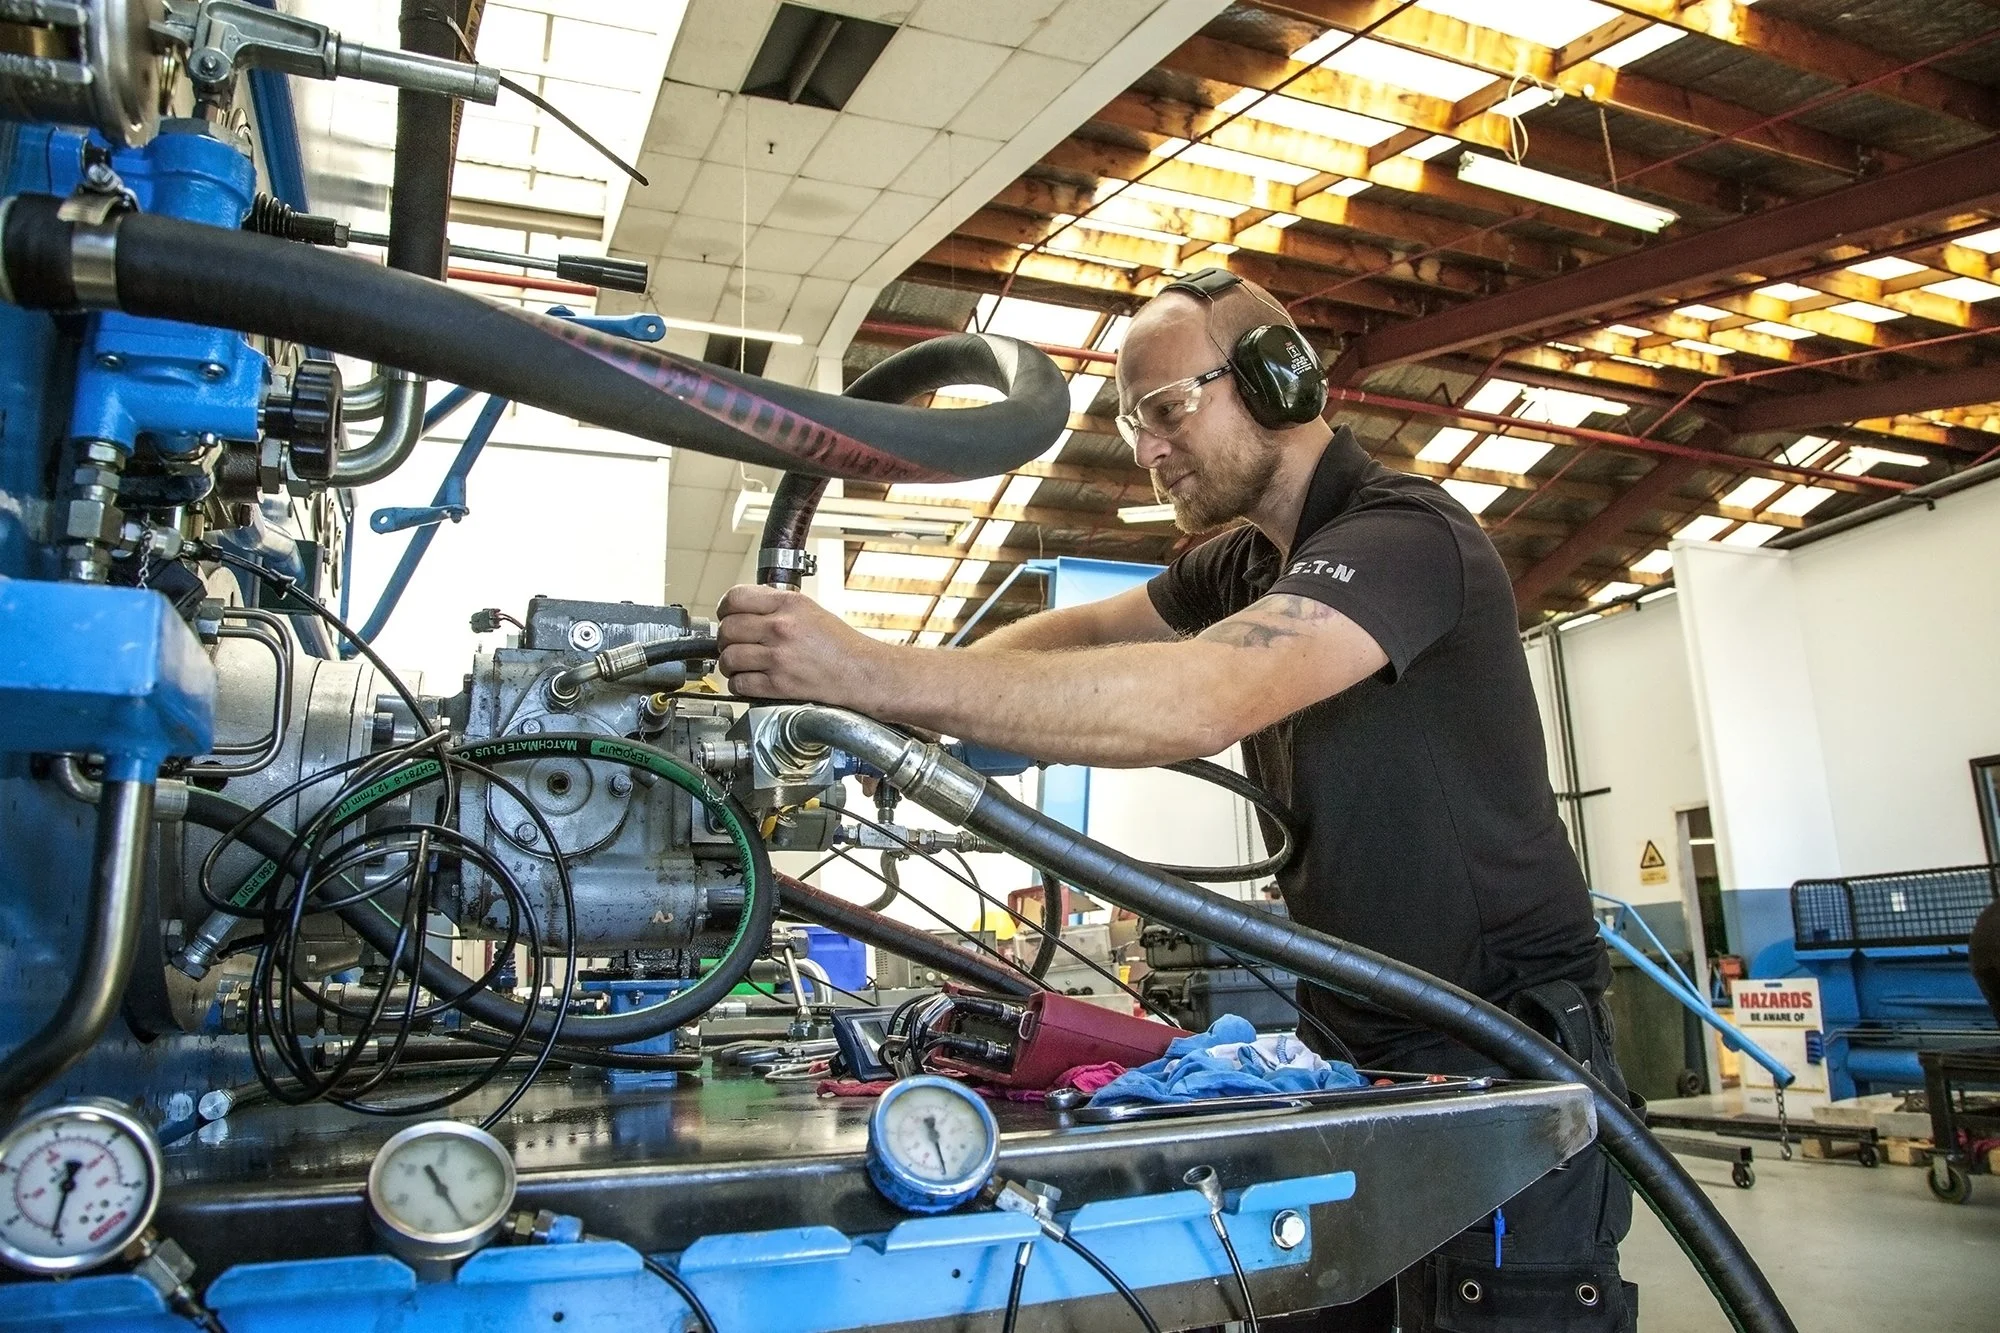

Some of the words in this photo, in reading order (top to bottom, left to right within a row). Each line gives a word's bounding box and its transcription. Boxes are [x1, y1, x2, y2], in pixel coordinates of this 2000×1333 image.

[475, 744, 506, 757] PLUS
[508, 740, 578, 752] MATCHMATE
[599, 745, 651, 763] AEROQUIP
[394, 762, 437, 785] GH781-8
[351, 782, 389, 805] 12.7mm
[1739, 991, 1813, 1009] HAZARDS
[1750, 1013, 1760, 1021] BE
[1763, 1013, 1791, 1022] AWARE
[1794, 1013, 1805, 1022] OF
